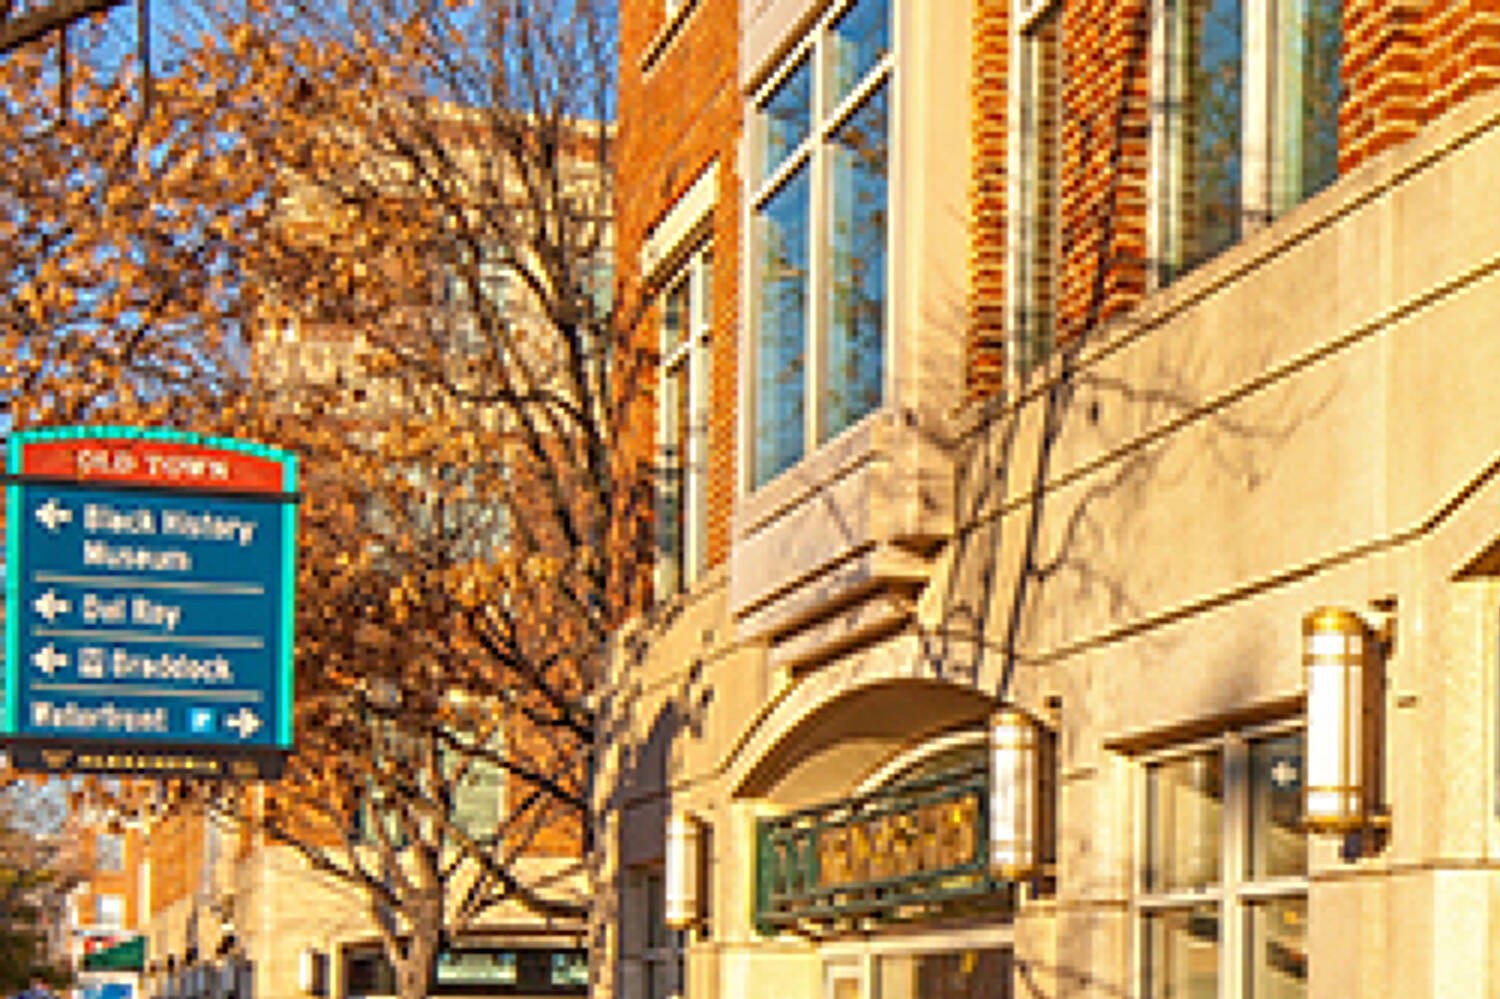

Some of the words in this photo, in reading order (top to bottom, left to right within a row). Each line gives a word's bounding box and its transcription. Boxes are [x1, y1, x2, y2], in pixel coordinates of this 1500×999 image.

[145, 455, 230, 481] TOWN
[83, 503, 156, 534] Black
[161, 508, 258, 547] History
[83, 540, 192, 571] Museum
[113, 648, 234, 684] Braddock
[30, 702, 169, 732] Waterfront
